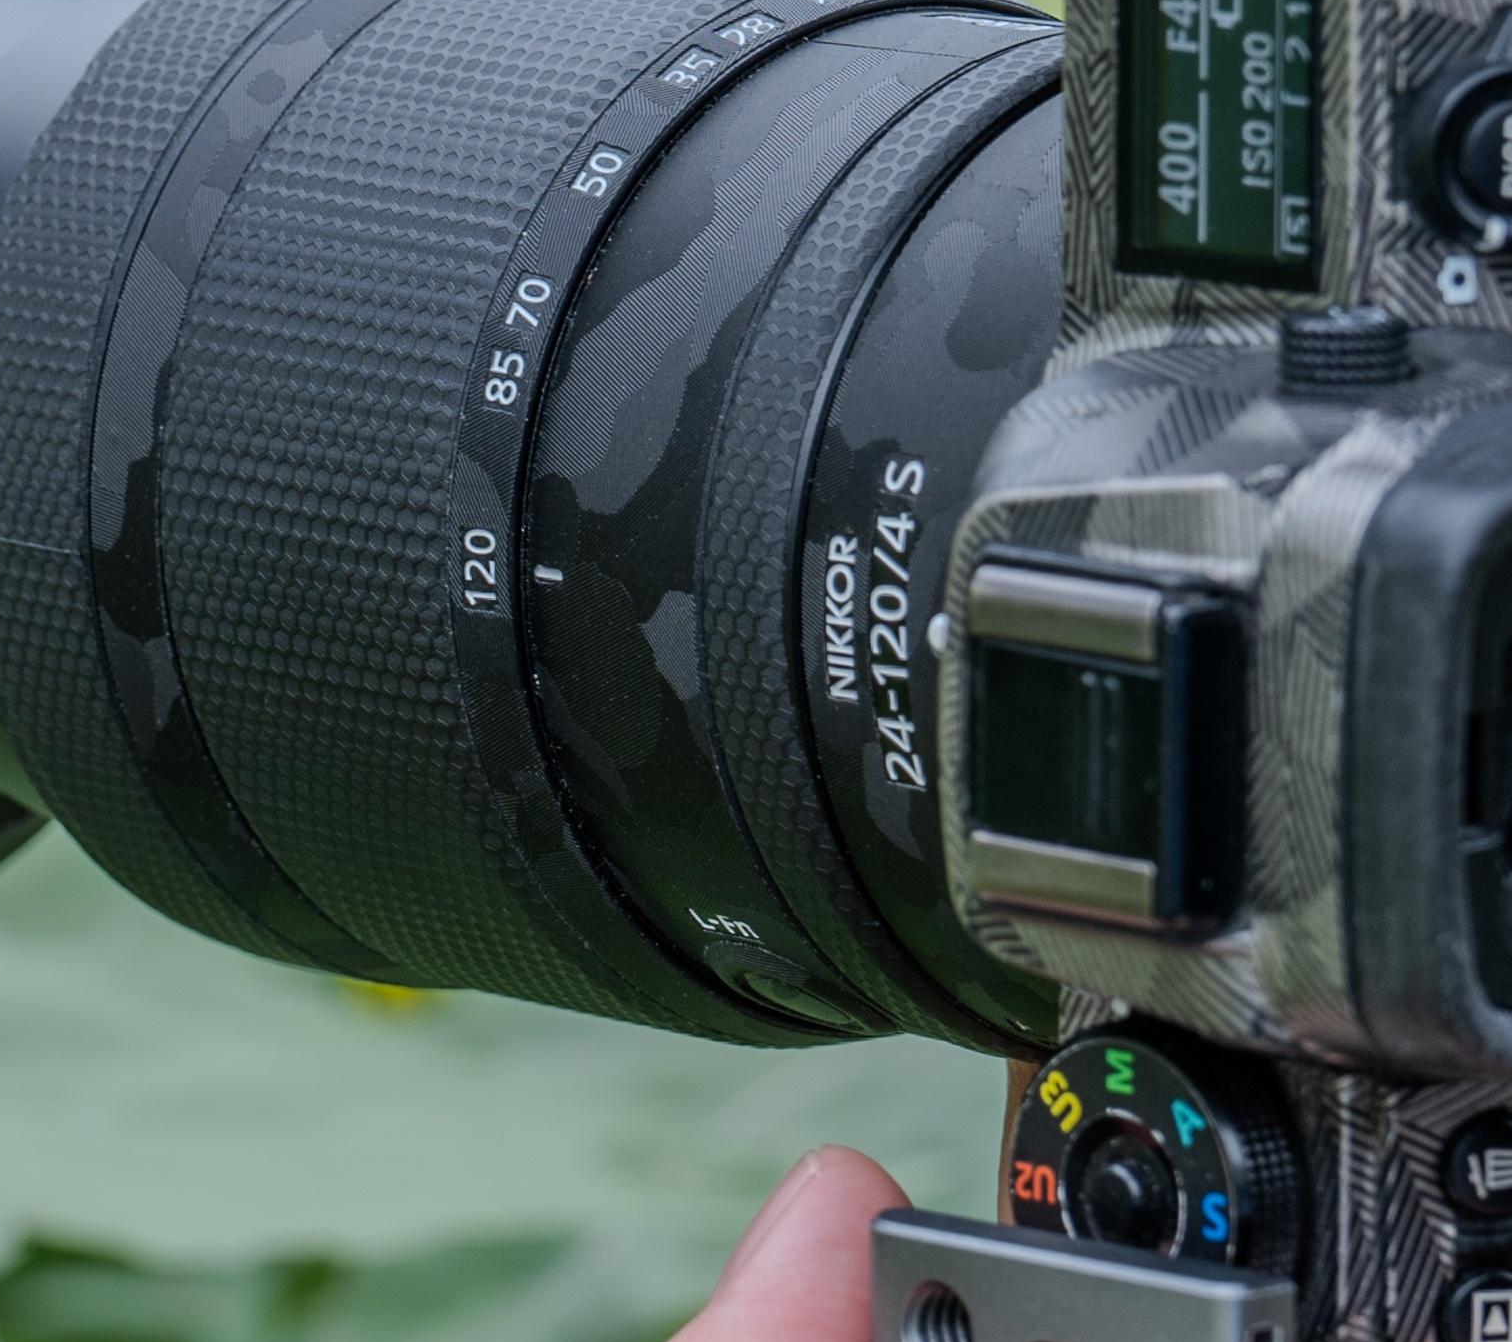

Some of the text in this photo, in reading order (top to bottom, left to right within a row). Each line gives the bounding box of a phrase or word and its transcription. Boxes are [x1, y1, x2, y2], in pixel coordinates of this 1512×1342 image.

[719, 15, 778, 47] 28
[663, 52, 716, 86] 35
[1243, 32, 1273, 190] ISO 200
[573, 150, 623, 198] 50
[1159, 121, 1198, 215] 400
[506, 277, 552, 329] 70
[484, 350, 525, 405] 85
[465, 529, 496, 606] 120
[825, 536, 857, 701] NIKKOR
[870, 461, 926, 790] 24-120/4 S
[689, 908, 759, 939] L-Fn
[1105, 1048, 1135, 1096] M
[1039, 1070, 1083, 1133] U3
[1170, 1099, 1206, 1148] A
[1014, 1161, 1056, 1205] U2
[1201, 1192, 1229, 1242] S
